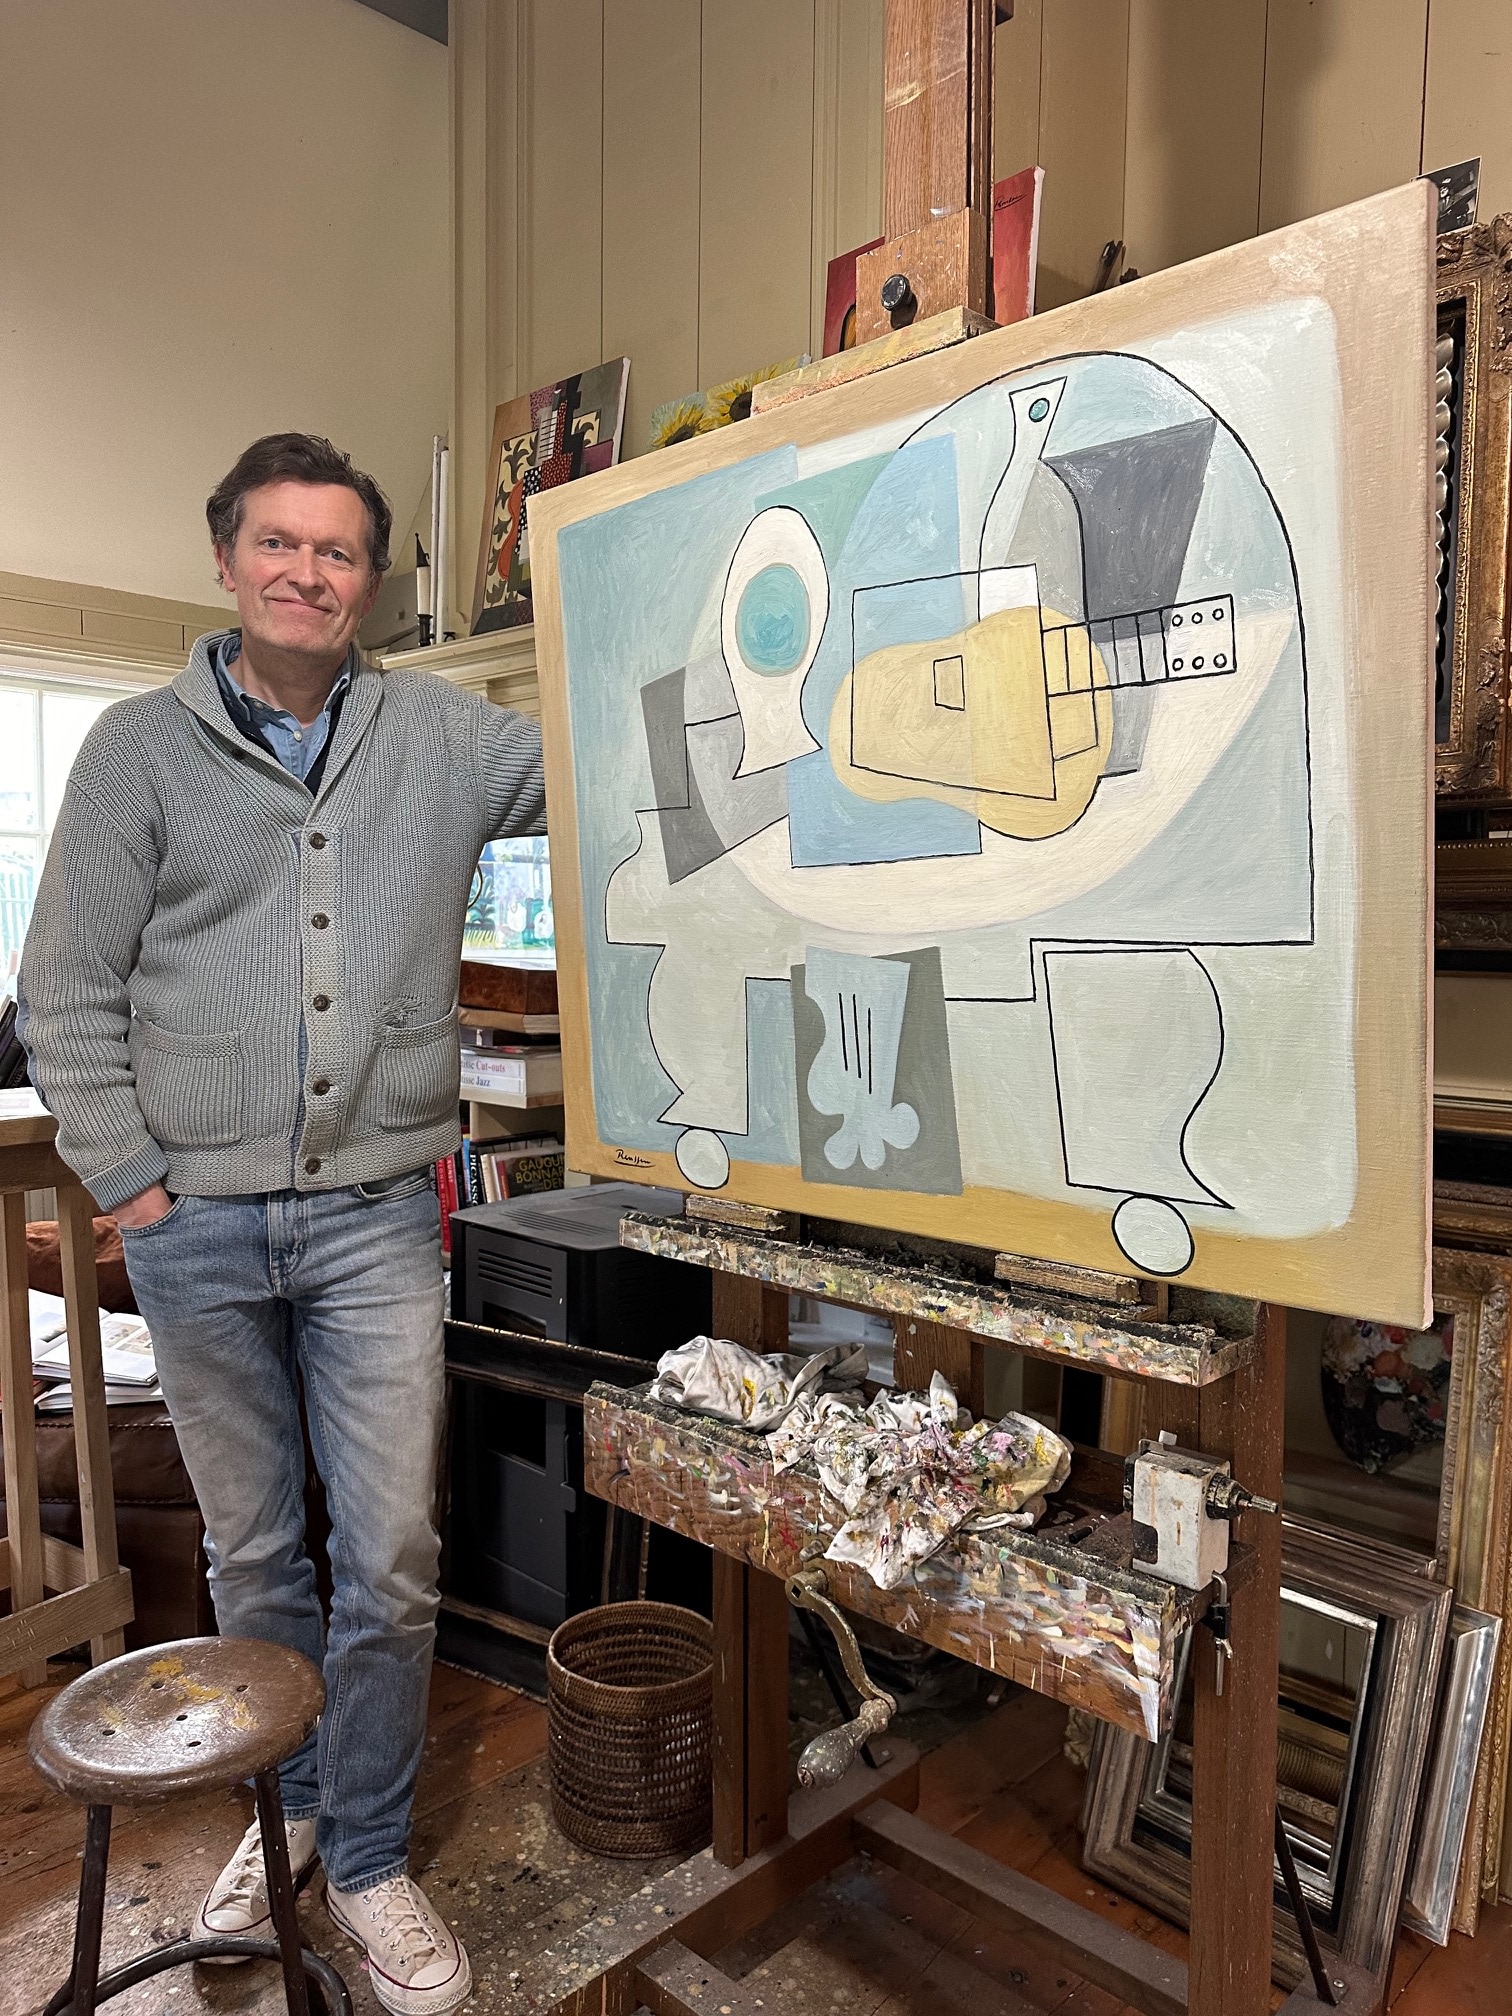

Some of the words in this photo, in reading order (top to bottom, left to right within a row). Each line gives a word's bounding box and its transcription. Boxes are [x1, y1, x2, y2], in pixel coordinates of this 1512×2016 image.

[461, 1059, 475, 1070] isse
[475, 1060, 506, 1073] Cut-outs
[461, 1074, 475, 1085] isse
[475, 1075, 491, 1087] Jazz
[519, 1154, 565, 1171] GAUGUI
[515, 1166, 565, 1184] BONNAR
